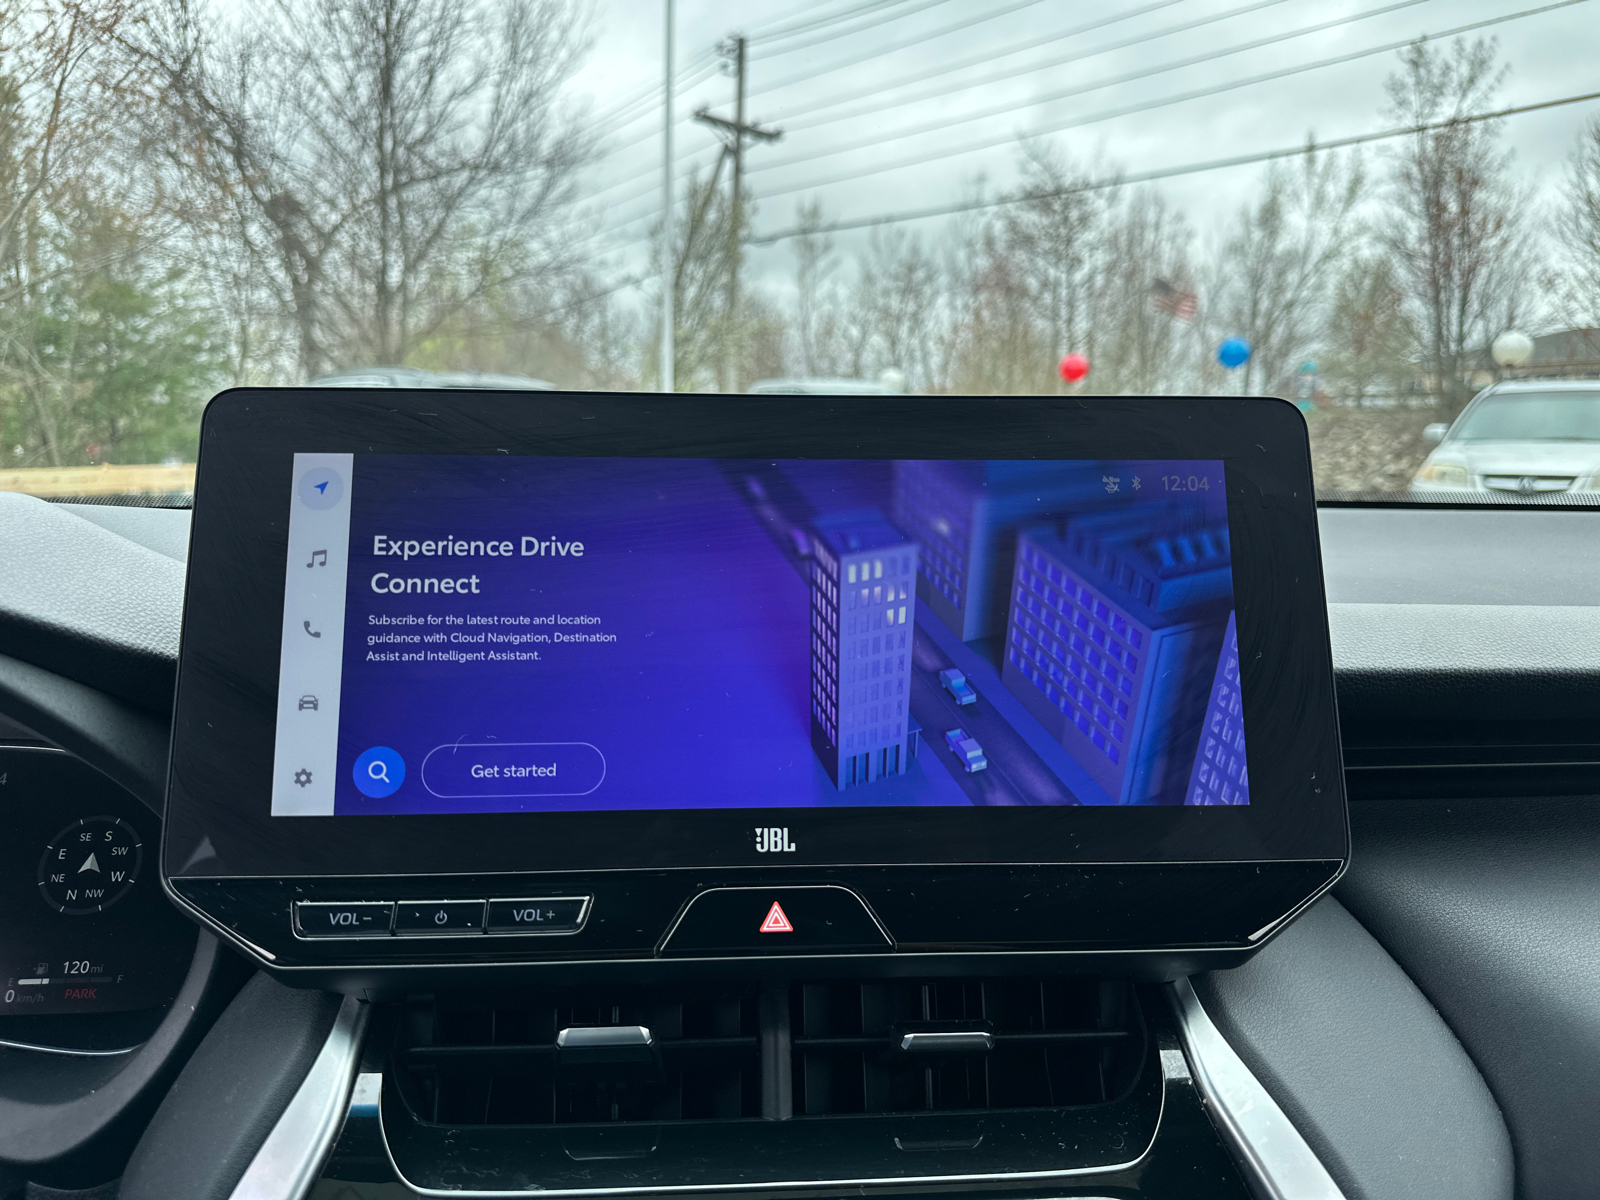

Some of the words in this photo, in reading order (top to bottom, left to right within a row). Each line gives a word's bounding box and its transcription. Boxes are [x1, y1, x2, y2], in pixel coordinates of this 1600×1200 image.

[1161, 475, 1210, 491] 12:04
[373, 535, 513, 560] Experience
[520, 536, 585, 557] Drive
[371, 572, 480, 594] Connect
[368, 614, 425, 625] Subscribe
[427, 614, 443, 625] for
[445, 614, 464, 625] the
[466, 614, 498, 625] latest
[500, 615, 531, 625] route
[532, 614, 556, 625] and
[557, 614, 601, 625] location
[367, 632, 421, 645] guidance
[423, 632, 448, 643] with
[450, 632, 485, 643] Cloud
[487, 632, 551, 644] Navigation,
[554, 632, 617, 643] Destination
[366, 651, 400, 661] Assist
[401, 650, 425, 661] and
[427, 650, 486, 663] Intelligent
[487, 650, 542, 661] Assistant.
[471, 764, 500, 779] Get
[503, 763, 558, 778] started
[80, 832, 92, 842] SE
[104, 831, 113, 842] S
[755, 827, 797, 853] JBL
[58, 849, 67, 860] E
[111, 847, 128, 856] SW
[51, 873, 65, 882] NE
[110, 871, 125, 882] W
[66, 890, 77, 900] N
[85, 889, 104, 898] NW
[63, 961, 90, 974] 120
[90, 964, 104, 974] mi
[117, 974, 124, 984] F
[5, 989, 15, 1003] 0
[16, 993, 44, 1003] km/h
[65, 989, 96, 998] PARK
